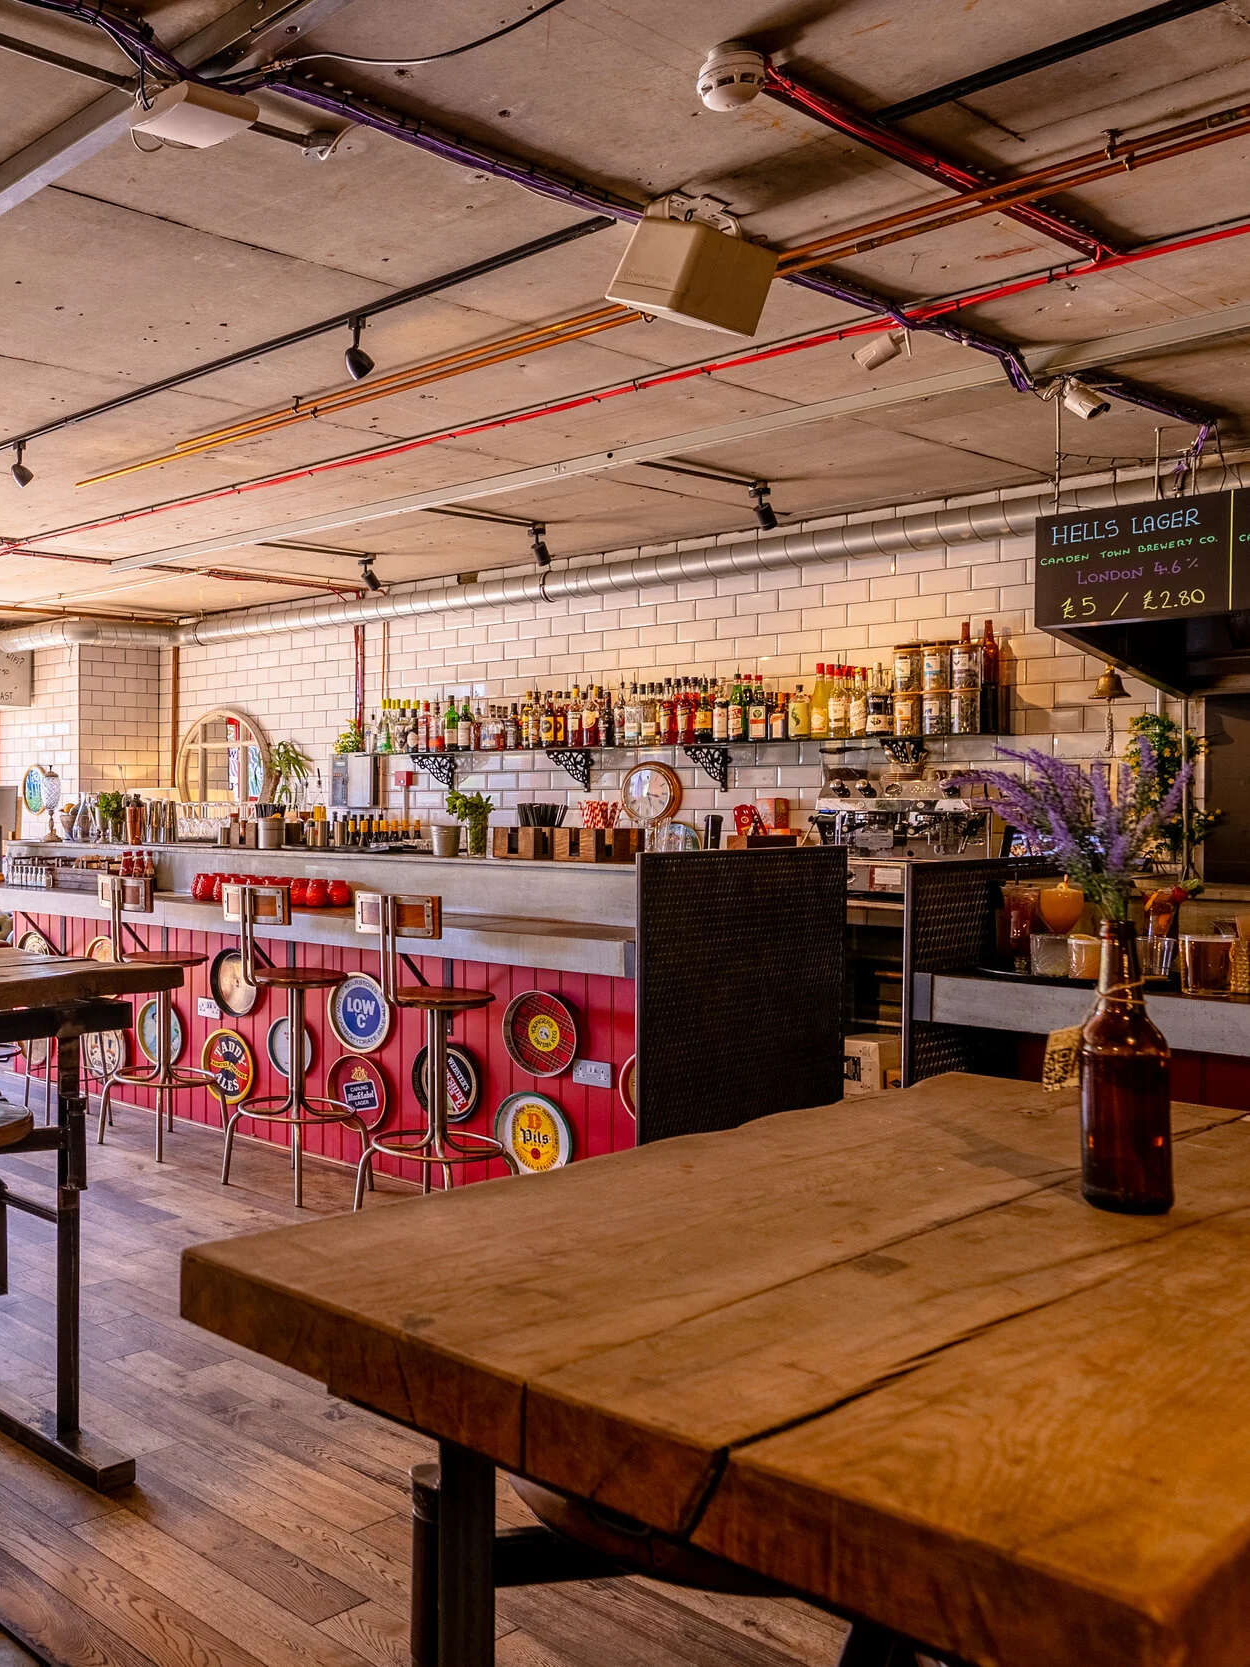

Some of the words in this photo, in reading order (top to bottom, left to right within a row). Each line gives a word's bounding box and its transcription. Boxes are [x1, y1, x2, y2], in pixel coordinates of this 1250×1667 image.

[1051, 519, 1120, 546] HELLS
[1131, 508, 1200, 535] LAGER
[1040, 553, 1090, 566] CAMDEN
[1100, 548, 1130, 559] TOWN
[1138, 537, 1193, 553] BREWERY
[1199, 535, 1218, 545] CO.
[1077, 566, 1144, 585] LONDON
[1060, 596, 1097, 619] £5
[1143, 588, 1206, 611] £2.80
[347, 996, 376, 1016] LOW
[213, 1040, 247, 1067] TADDY
[215, 1072, 240, 1092] ALES
[350, 1084, 369, 1092] CARLING
[354, 1099, 370, 1107] LAGER
[519, 1126, 549, 1145] Pils
